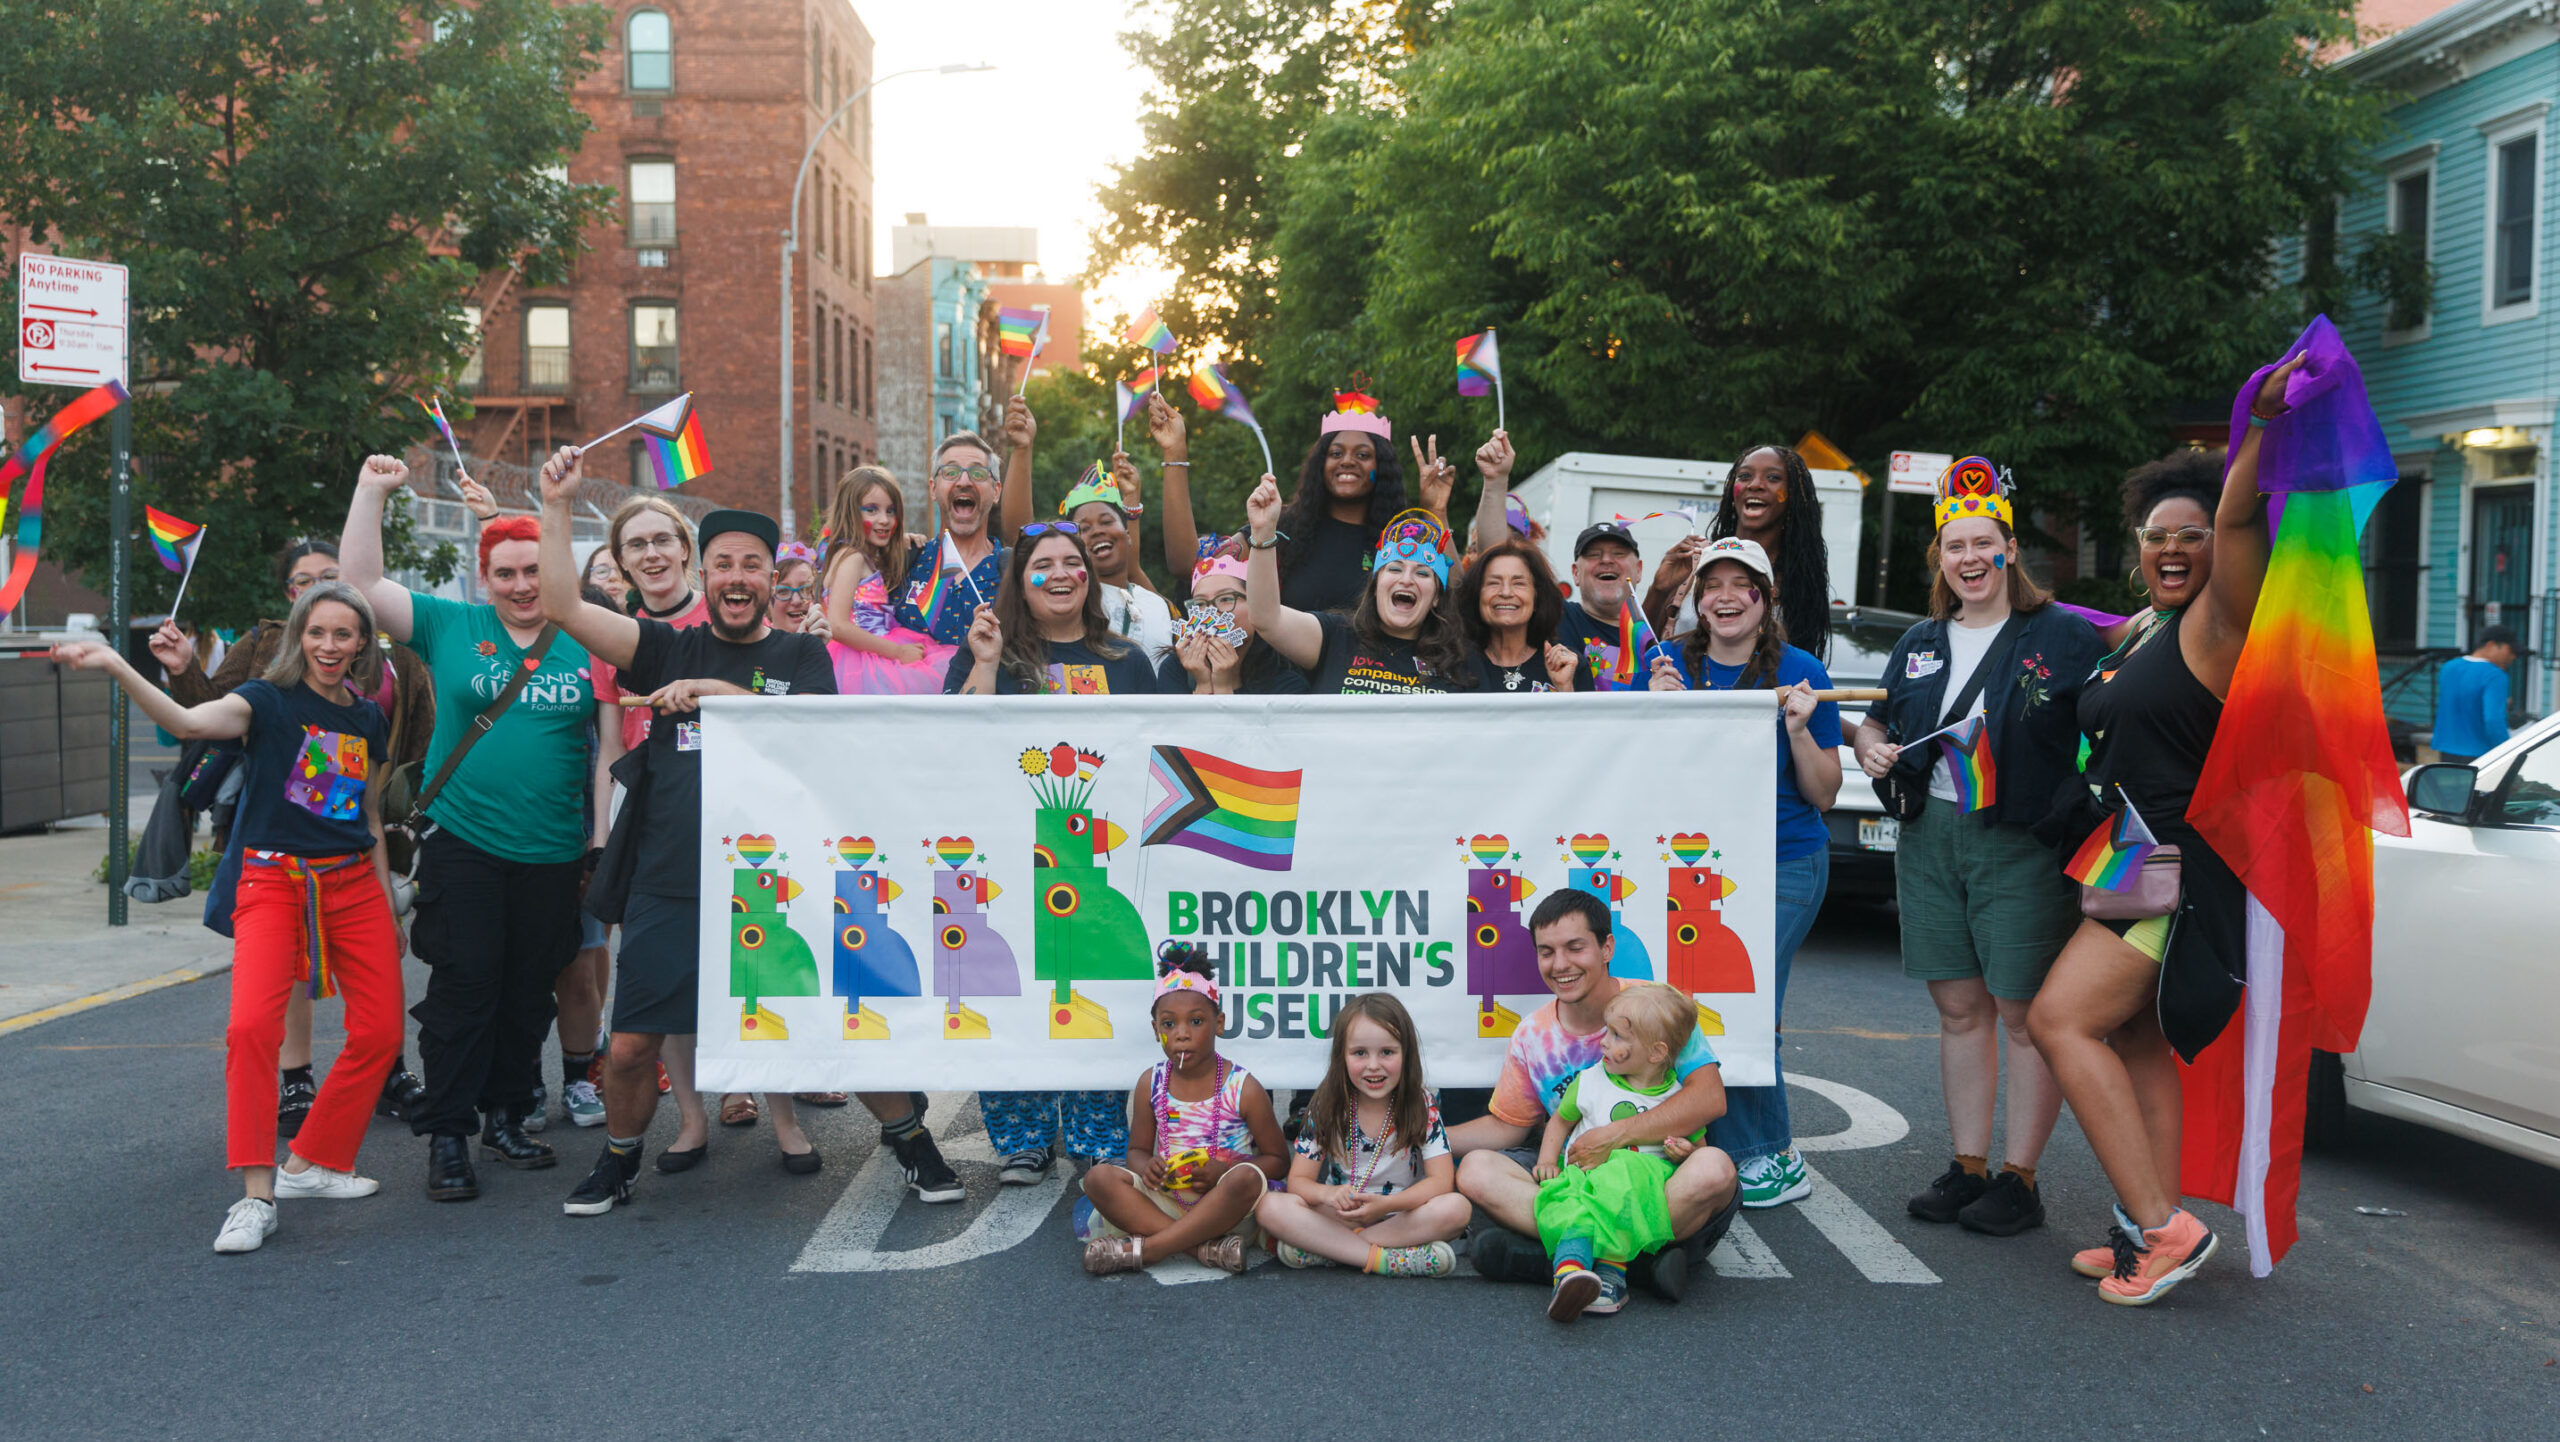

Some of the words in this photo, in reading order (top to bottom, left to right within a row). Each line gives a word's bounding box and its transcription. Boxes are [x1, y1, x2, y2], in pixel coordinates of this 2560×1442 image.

[28, 262, 45, 275] NO
[50, 265, 103, 282] PARKING
[28, 277, 79, 294] Anytime
[490, 662, 578, 685] SEOND
[1348, 667, 1420, 686] empathy.
[531, 703, 582, 713] FOUNDER
[1169, 890, 1429, 935] BROOKLYN
[1172, 940, 1455, 987] HILDREN'S
[1219, 993, 1357, 1039] USEU
